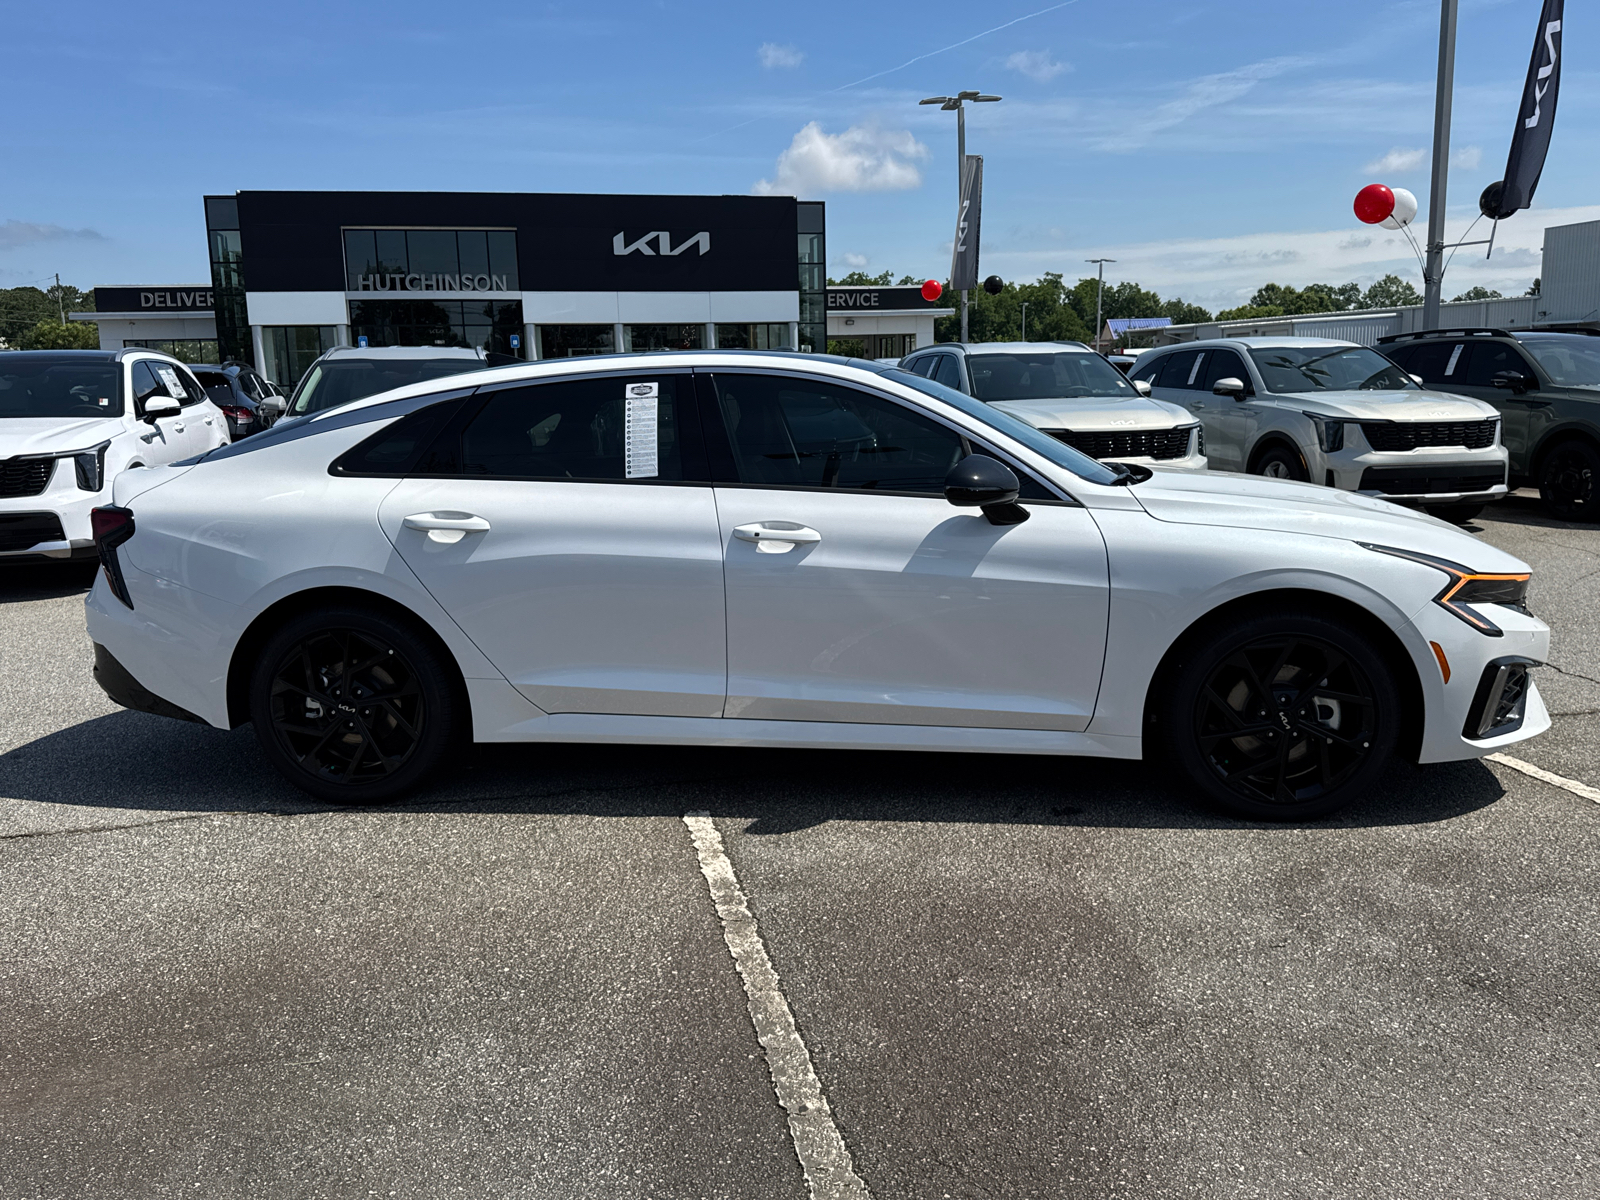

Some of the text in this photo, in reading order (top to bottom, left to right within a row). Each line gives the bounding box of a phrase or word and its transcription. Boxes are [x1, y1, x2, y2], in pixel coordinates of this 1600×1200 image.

[1525, 19, 1561, 129] KIA
[612, 230, 711, 256] KIA
[357, 273, 508, 292] HUTCHINSON
[338, 703, 356, 714] KIA
[1279, 711, 1291, 730] KIA
